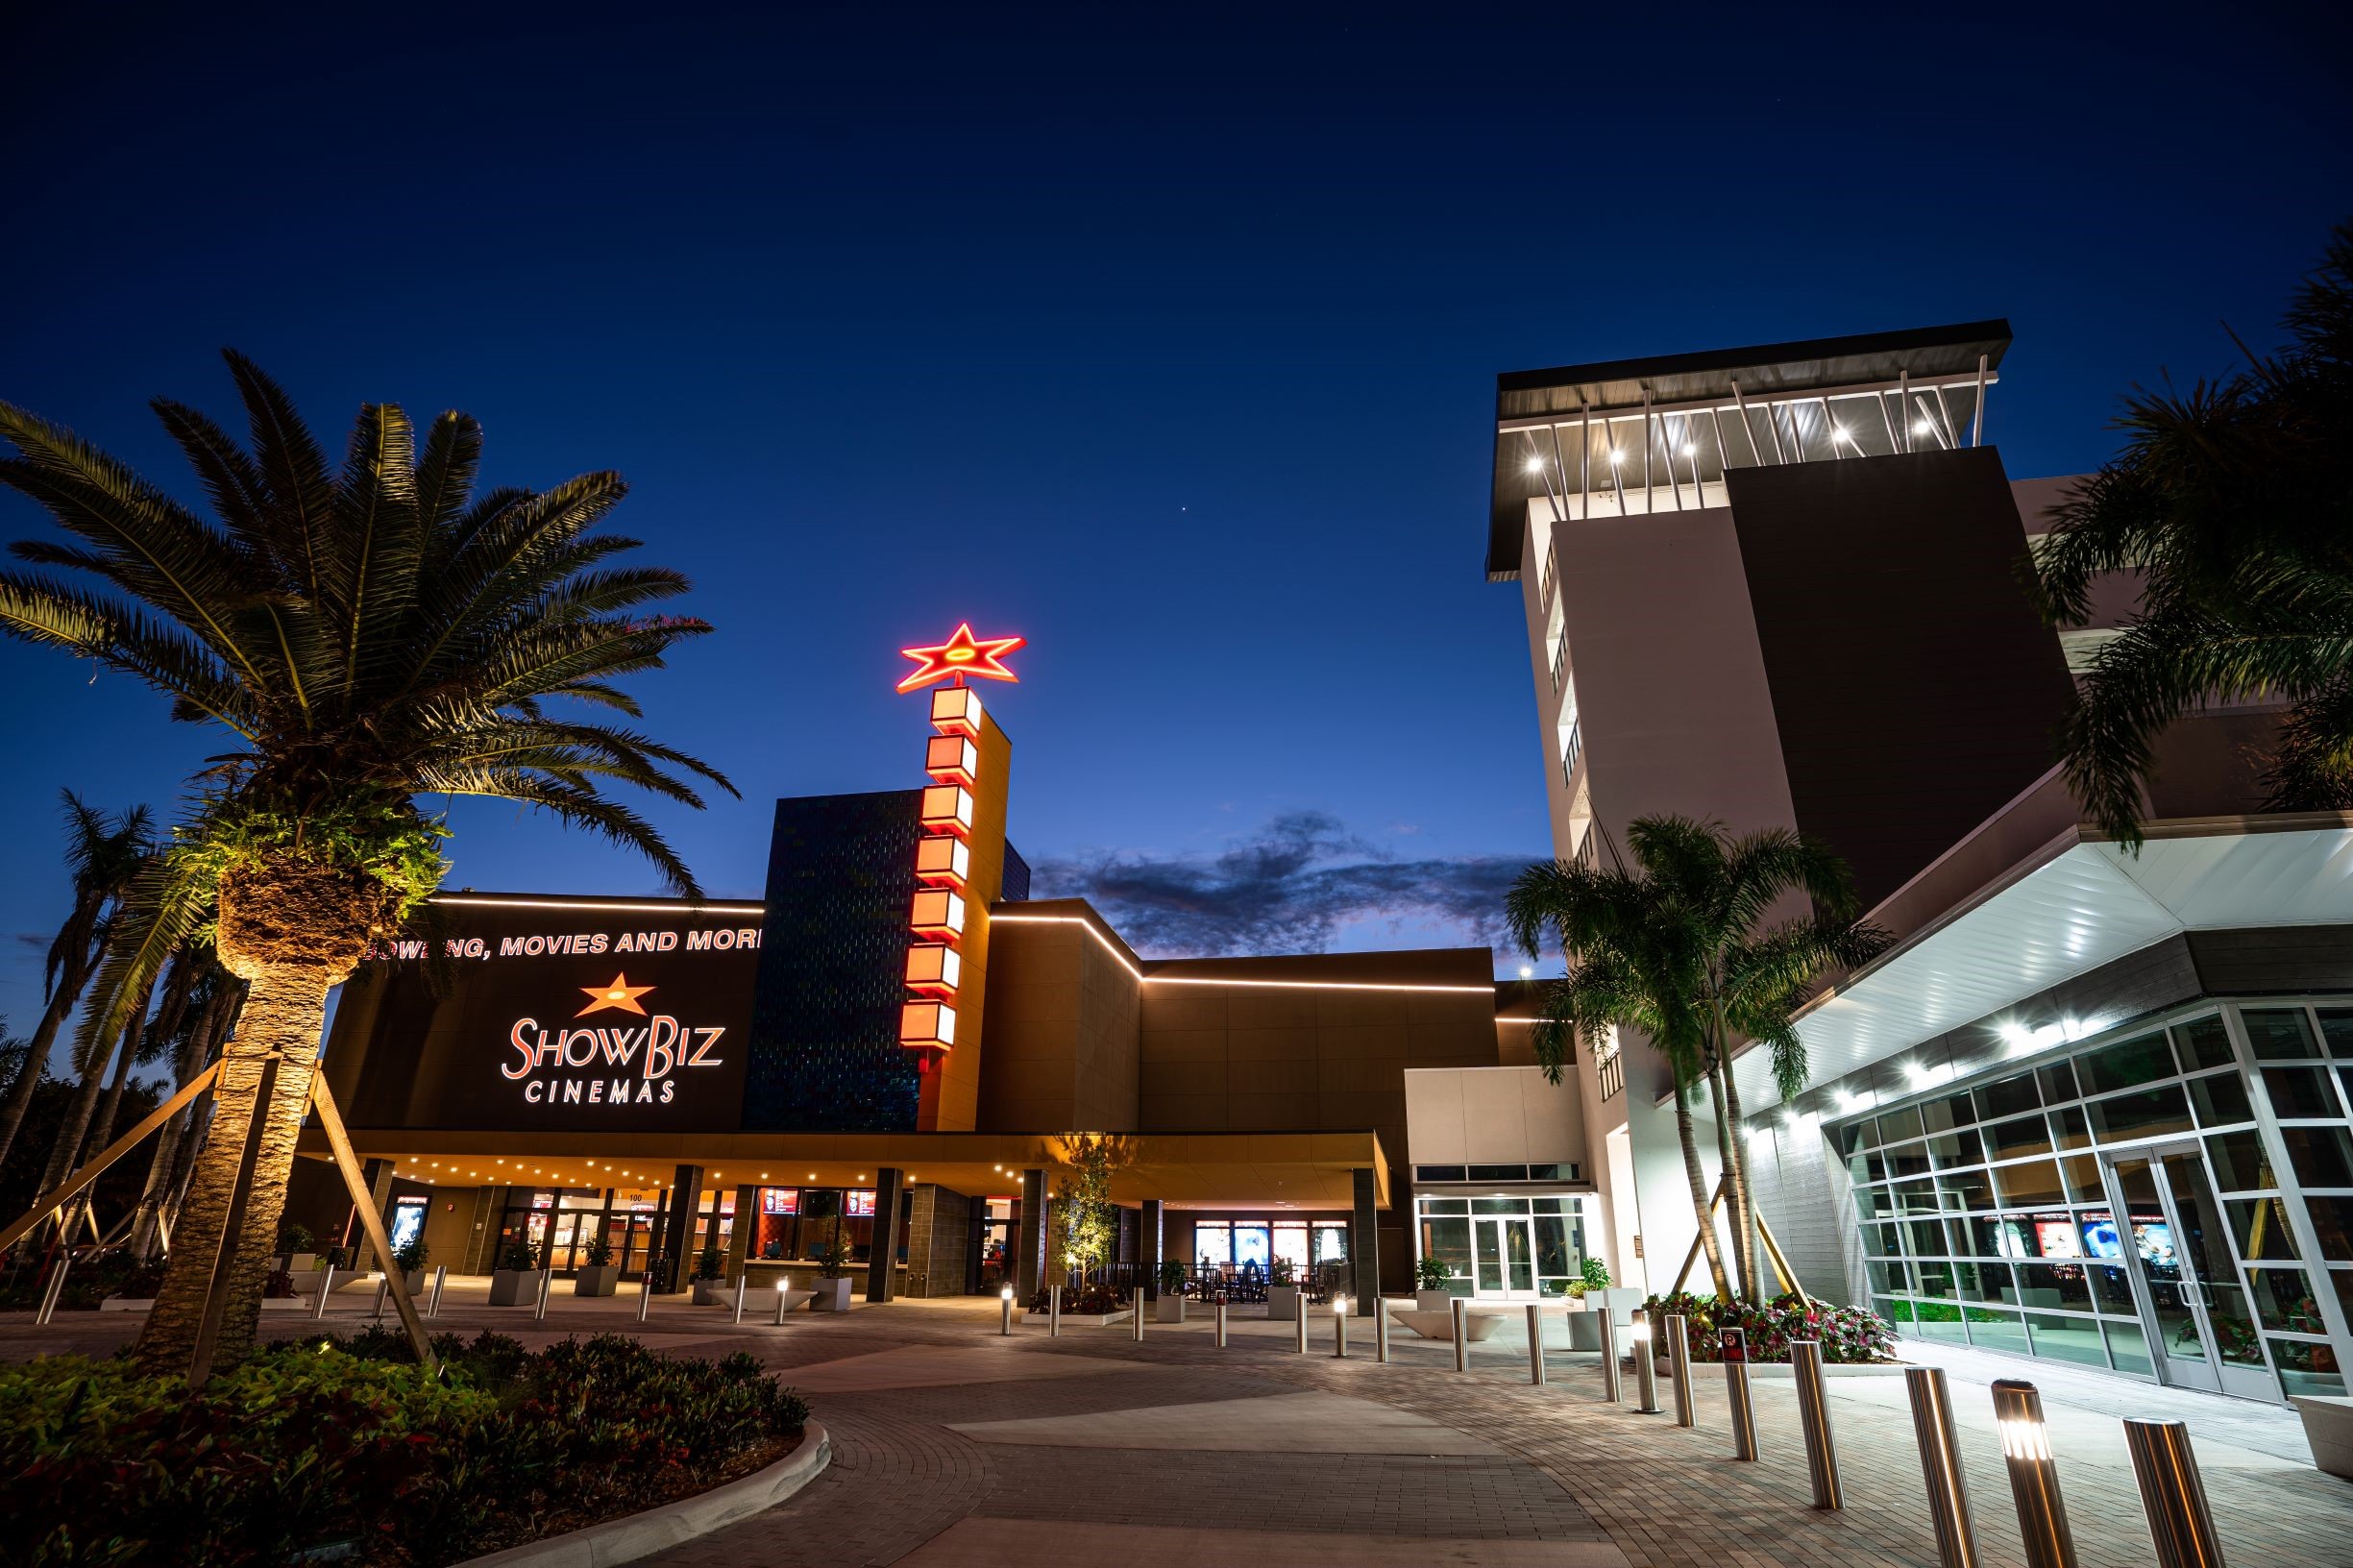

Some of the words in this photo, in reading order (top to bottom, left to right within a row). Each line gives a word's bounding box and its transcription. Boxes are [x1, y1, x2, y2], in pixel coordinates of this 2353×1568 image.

[363, 938, 491, 961] BOWNG,
[500, 933, 609, 956] MOVIES
[614, 931, 678, 953] AND
[686, 928, 763, 950] MOR
[525, 1078, 674, 1105] CINEMAS
